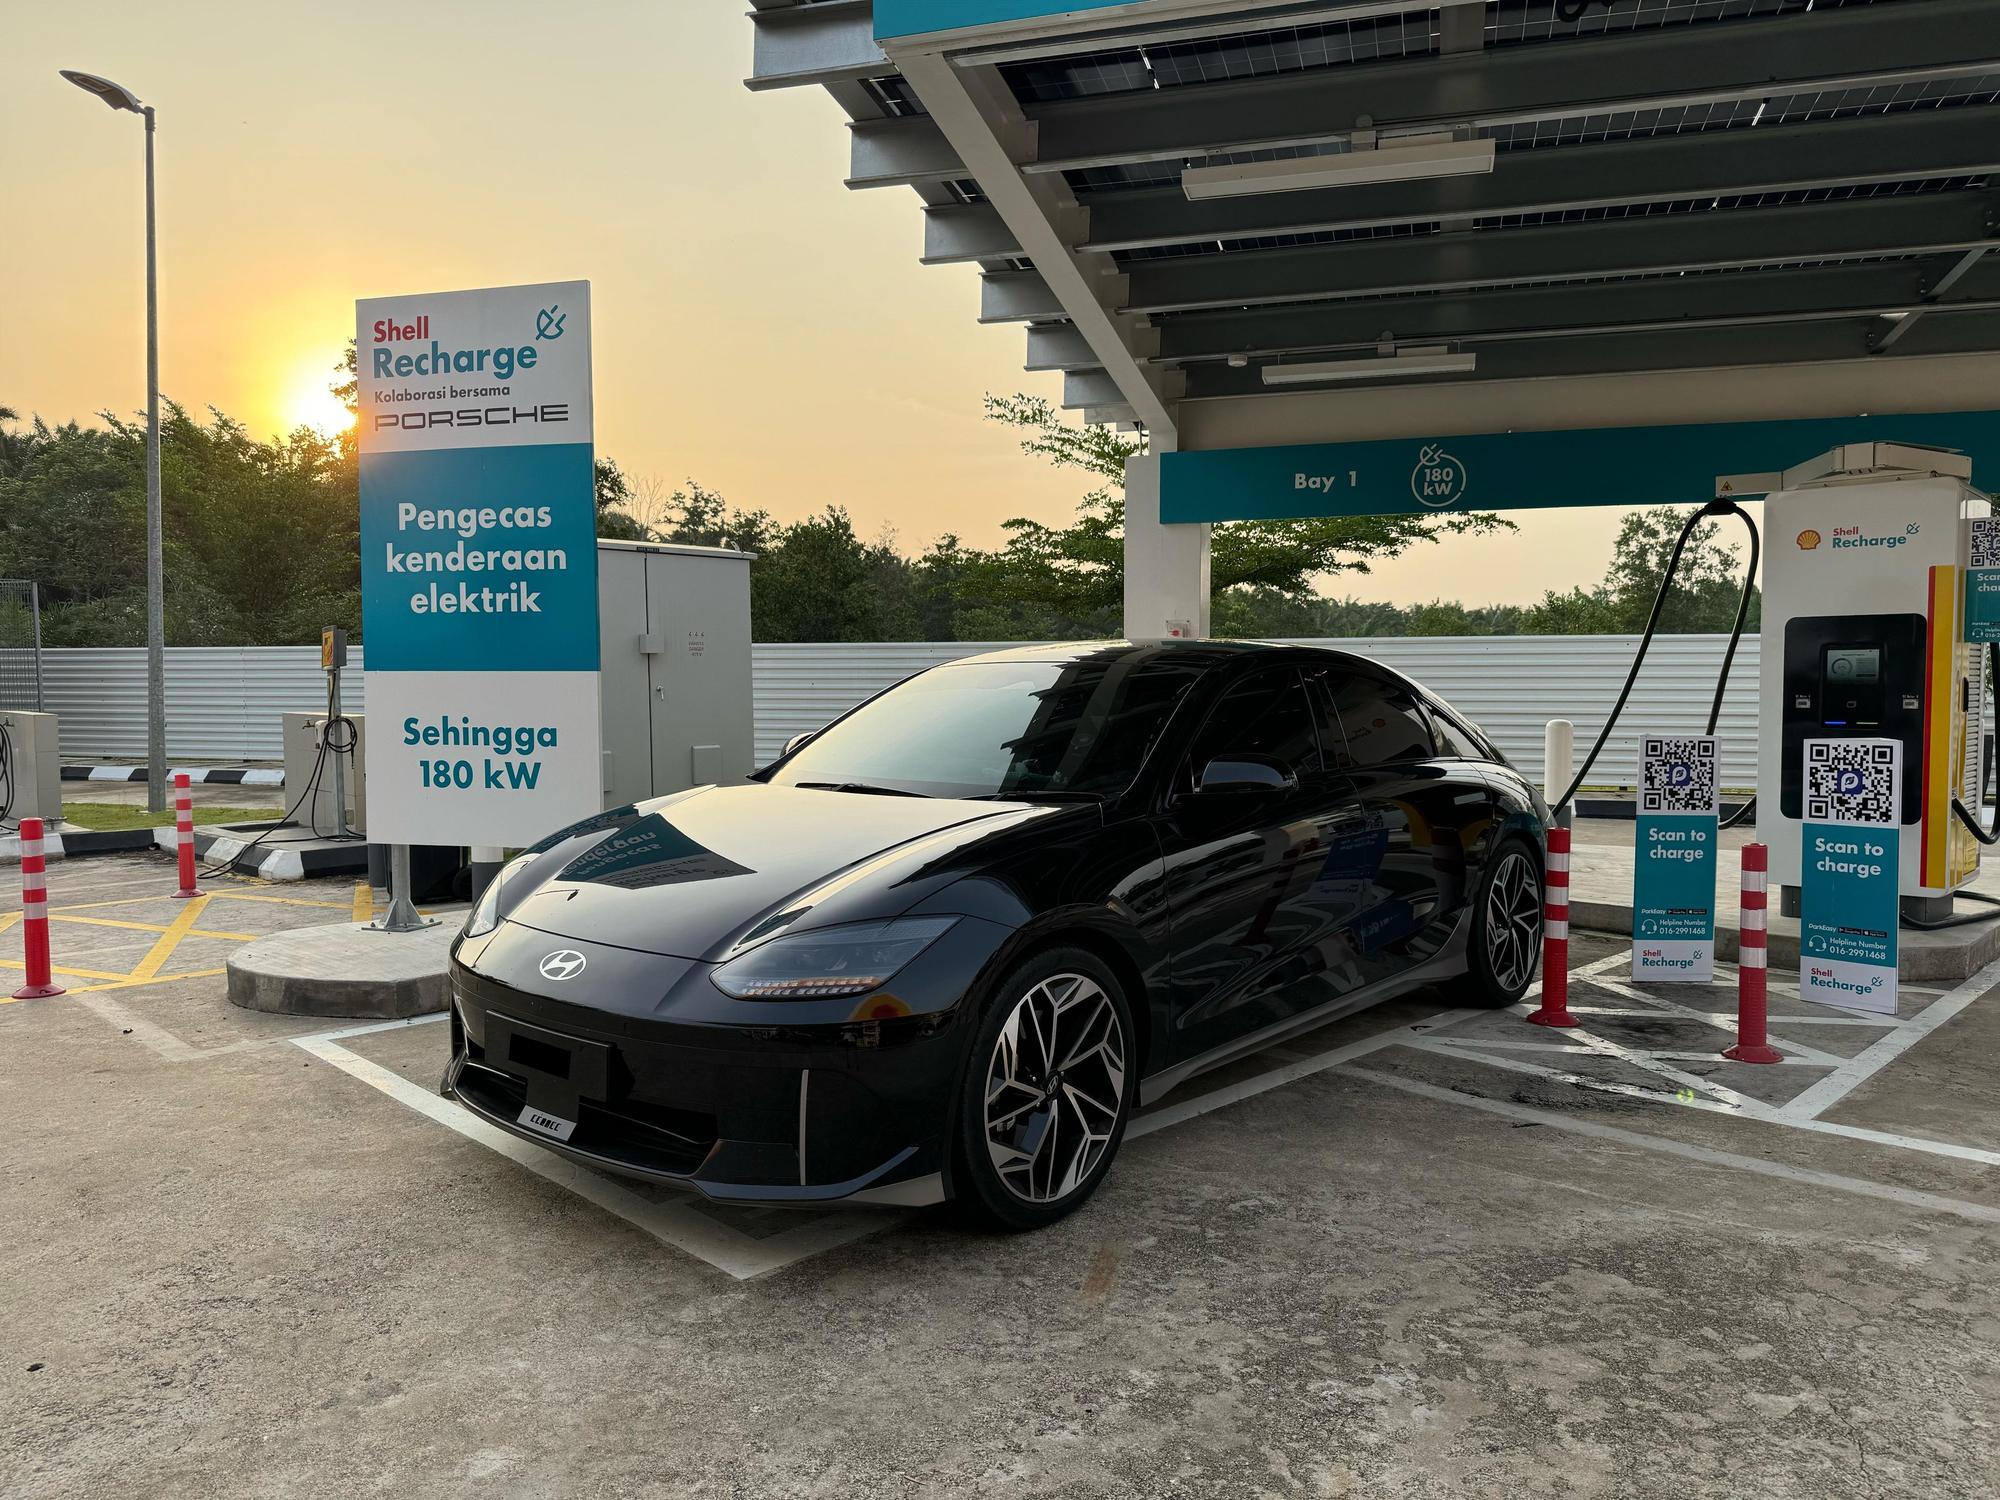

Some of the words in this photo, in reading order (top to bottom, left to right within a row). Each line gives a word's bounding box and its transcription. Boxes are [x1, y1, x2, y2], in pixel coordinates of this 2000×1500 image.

[373, 315, 429, 343] Shell
[373, 340, 538, 380] Recharge
[374, 386, 447, 404] Kolaborasi
[449, 385, 511, 399] bersama
[374, 403, 569, 432] PORSCHE
[1294, 472, 1336, 493] Bay
[1349, 470, 1358, 487] 1
[1424, 467, 1454, 483] 180
[1423, 482, 1453, 496] kW
[398, 502, 552, 538] Pengecas
[1833, 526, 1859, 537] Shell
[1832, 534, 1907, 549] Recharge
[386, 540, 568, 574] kenderaan
[410, 581, 542, 614] elektrik
[403, 716, 558, 756] Sehingga
[419, 760, 474, 789] 180
[484, 759, 542, 790] kW
[1648, 827, 1686, 842] Scan
[1690, 829, 1707, 842] to
[1649, 844, 1704, 863] charge
[1815, 837, 1859, 855] Scan
[1863, 842, 1885, 857] to
[1816, 856, 1882, 879] charge
[1659, 919, 1683, 927] Helpline
[1659, 927, 1706, 935] 016-2991468
[1808, 923, 1837, 933] ParkEasy
[1642, 949, 1662, 957] Shell
[1829, 937, 1857, 947] Helpline
[1858, 940, 1887, 950] Number
[1829, 945, 1886, 960] 016-2991468
[1642, 957, 1694, 969] Recharge
[1810, 967, 1833, 978] Shell
[1810, 975, 1872, 995] Recharge
